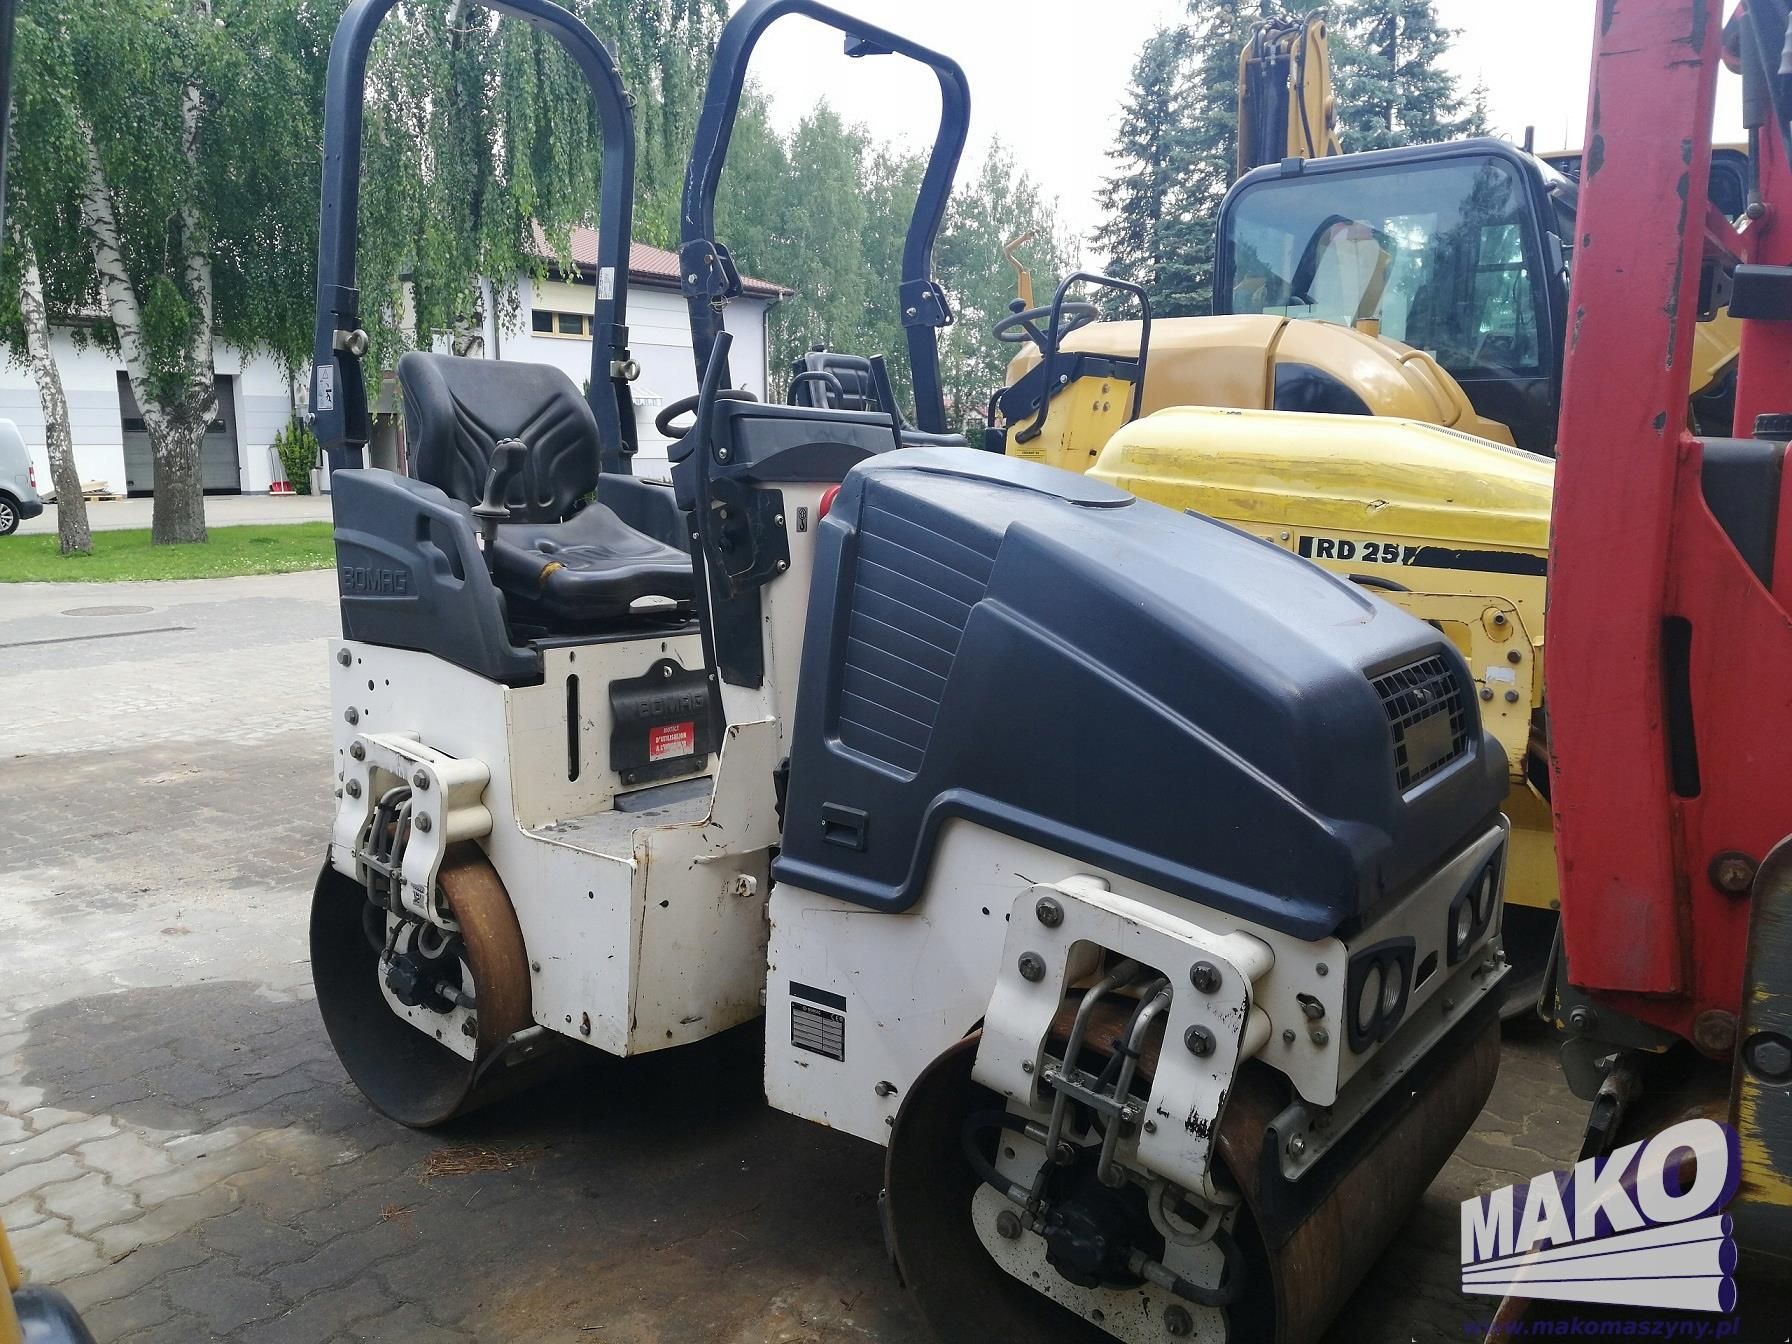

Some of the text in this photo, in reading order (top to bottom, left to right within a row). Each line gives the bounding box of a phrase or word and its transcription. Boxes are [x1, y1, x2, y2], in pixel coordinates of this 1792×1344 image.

[1316, 538, 1356, 560] RD
[342, 566, 409, 593] BOMAG
[640, 692, 704, 716] BOMAG
